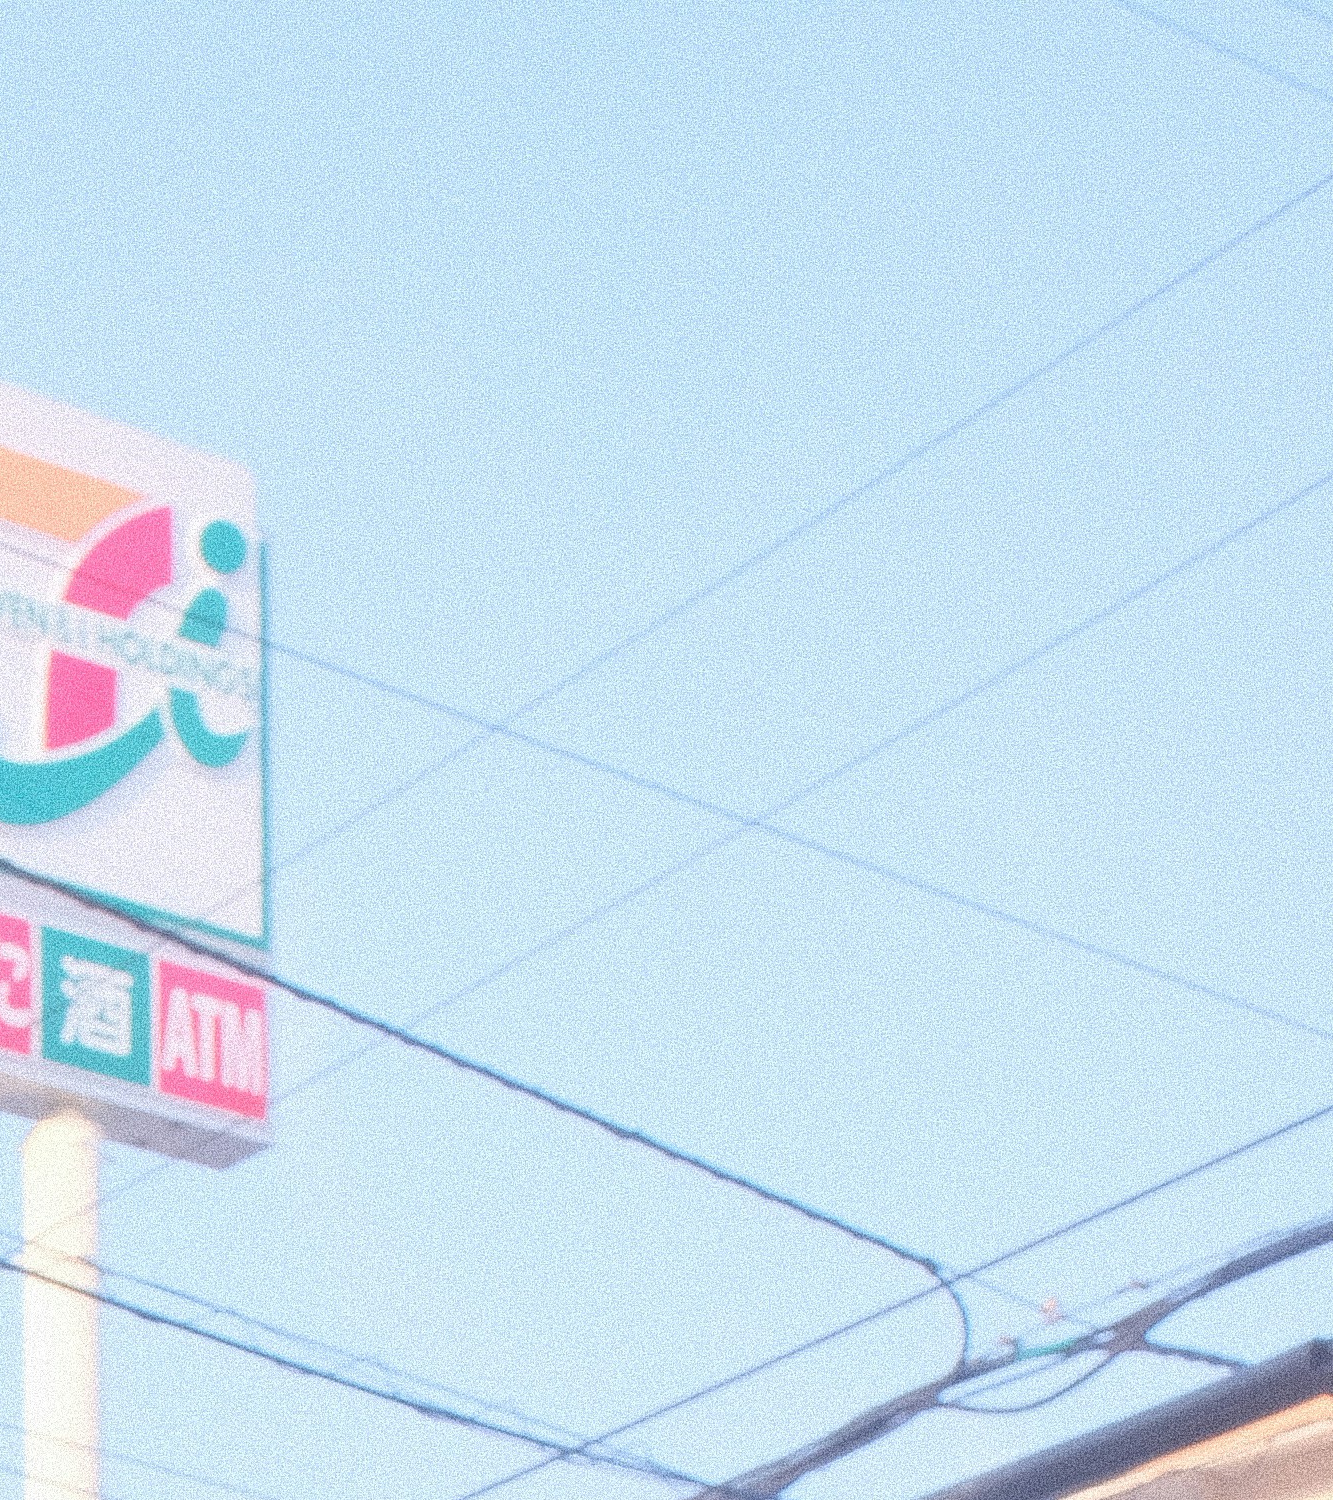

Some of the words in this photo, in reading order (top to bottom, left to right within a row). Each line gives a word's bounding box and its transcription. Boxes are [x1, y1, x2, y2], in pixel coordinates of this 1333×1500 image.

[96, 622, 260, 701] HOLDINGS
[58, 954, 134, 1058] 酒
[161, 985, 263, 1098] ATM
